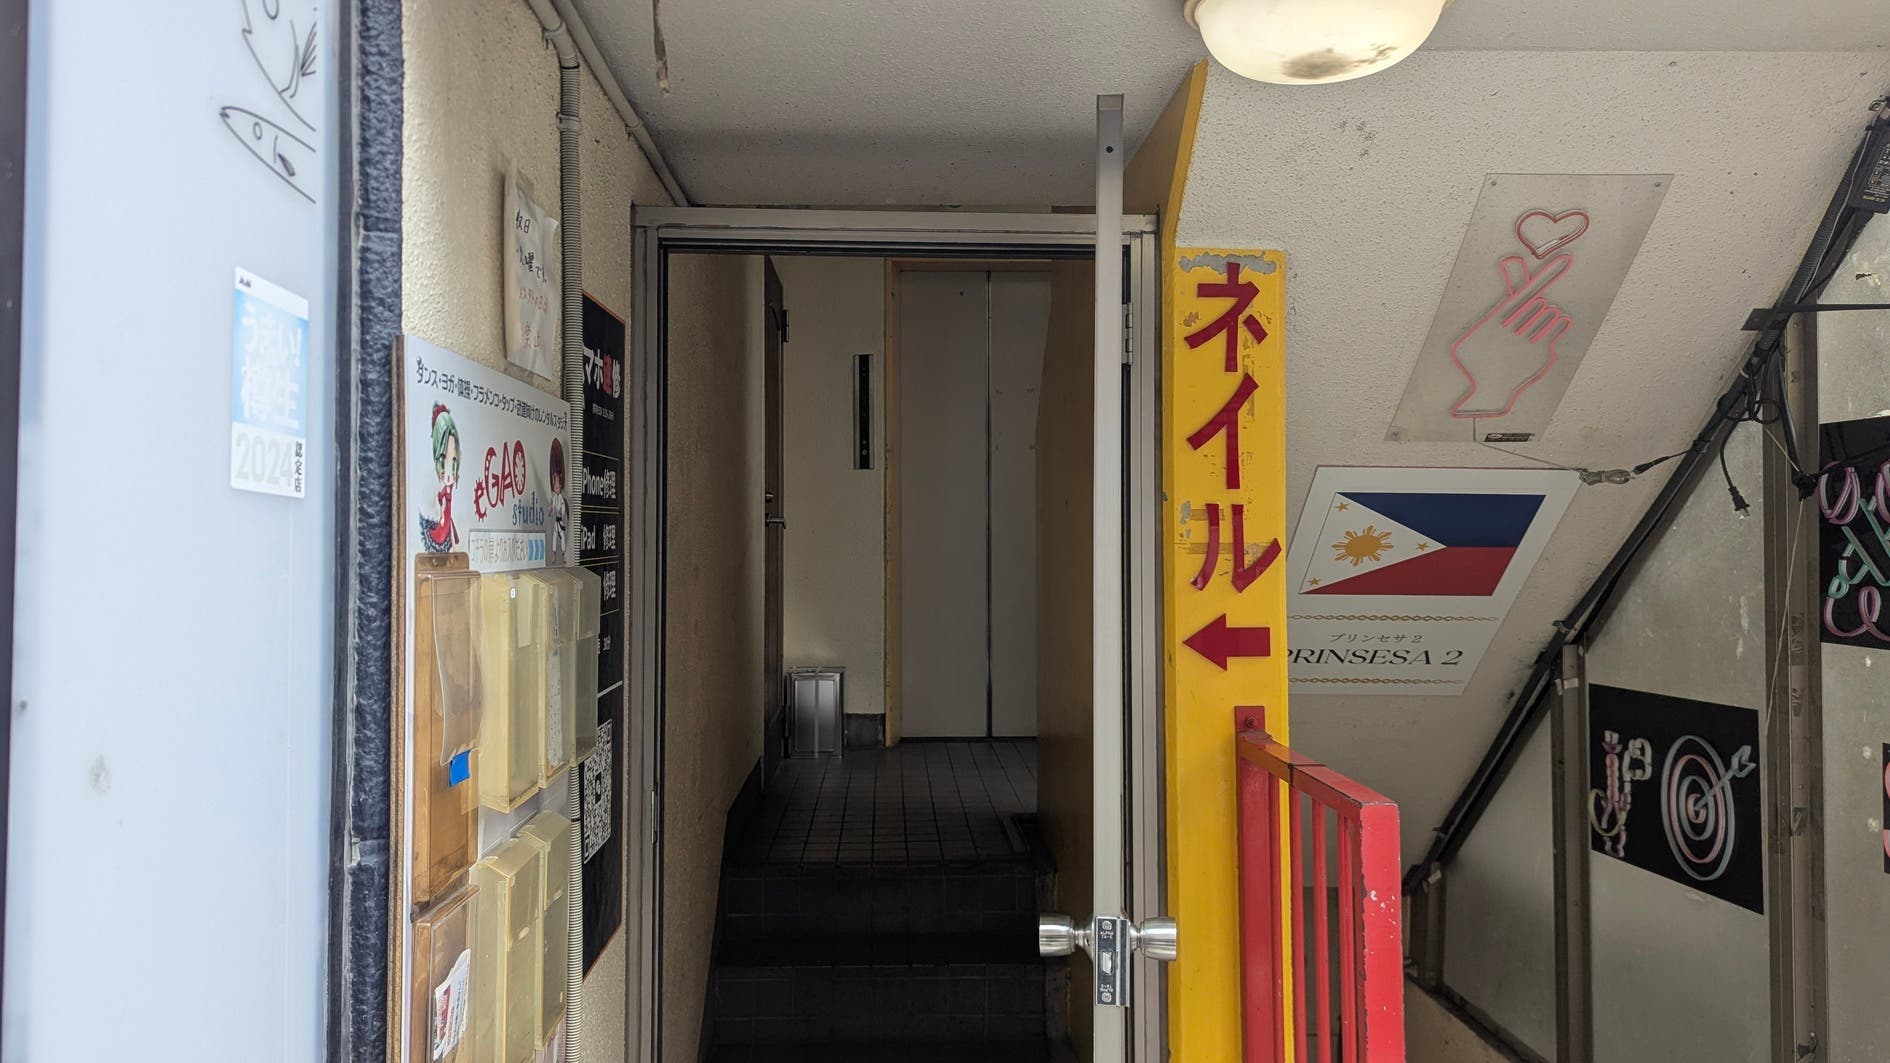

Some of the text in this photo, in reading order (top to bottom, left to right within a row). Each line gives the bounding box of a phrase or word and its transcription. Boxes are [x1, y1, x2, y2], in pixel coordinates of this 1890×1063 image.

[1184, 263, 1282, 594] ネイル
[234, 432, 295, 487] 2024
[583, 467, 617, 499] Phone修理
[512, 492, 545, 526] studio
[603, 524, 616, 550] 修理
[603, 571, 616, 600] 修理
[1441, 650, 1463, 665] 2
